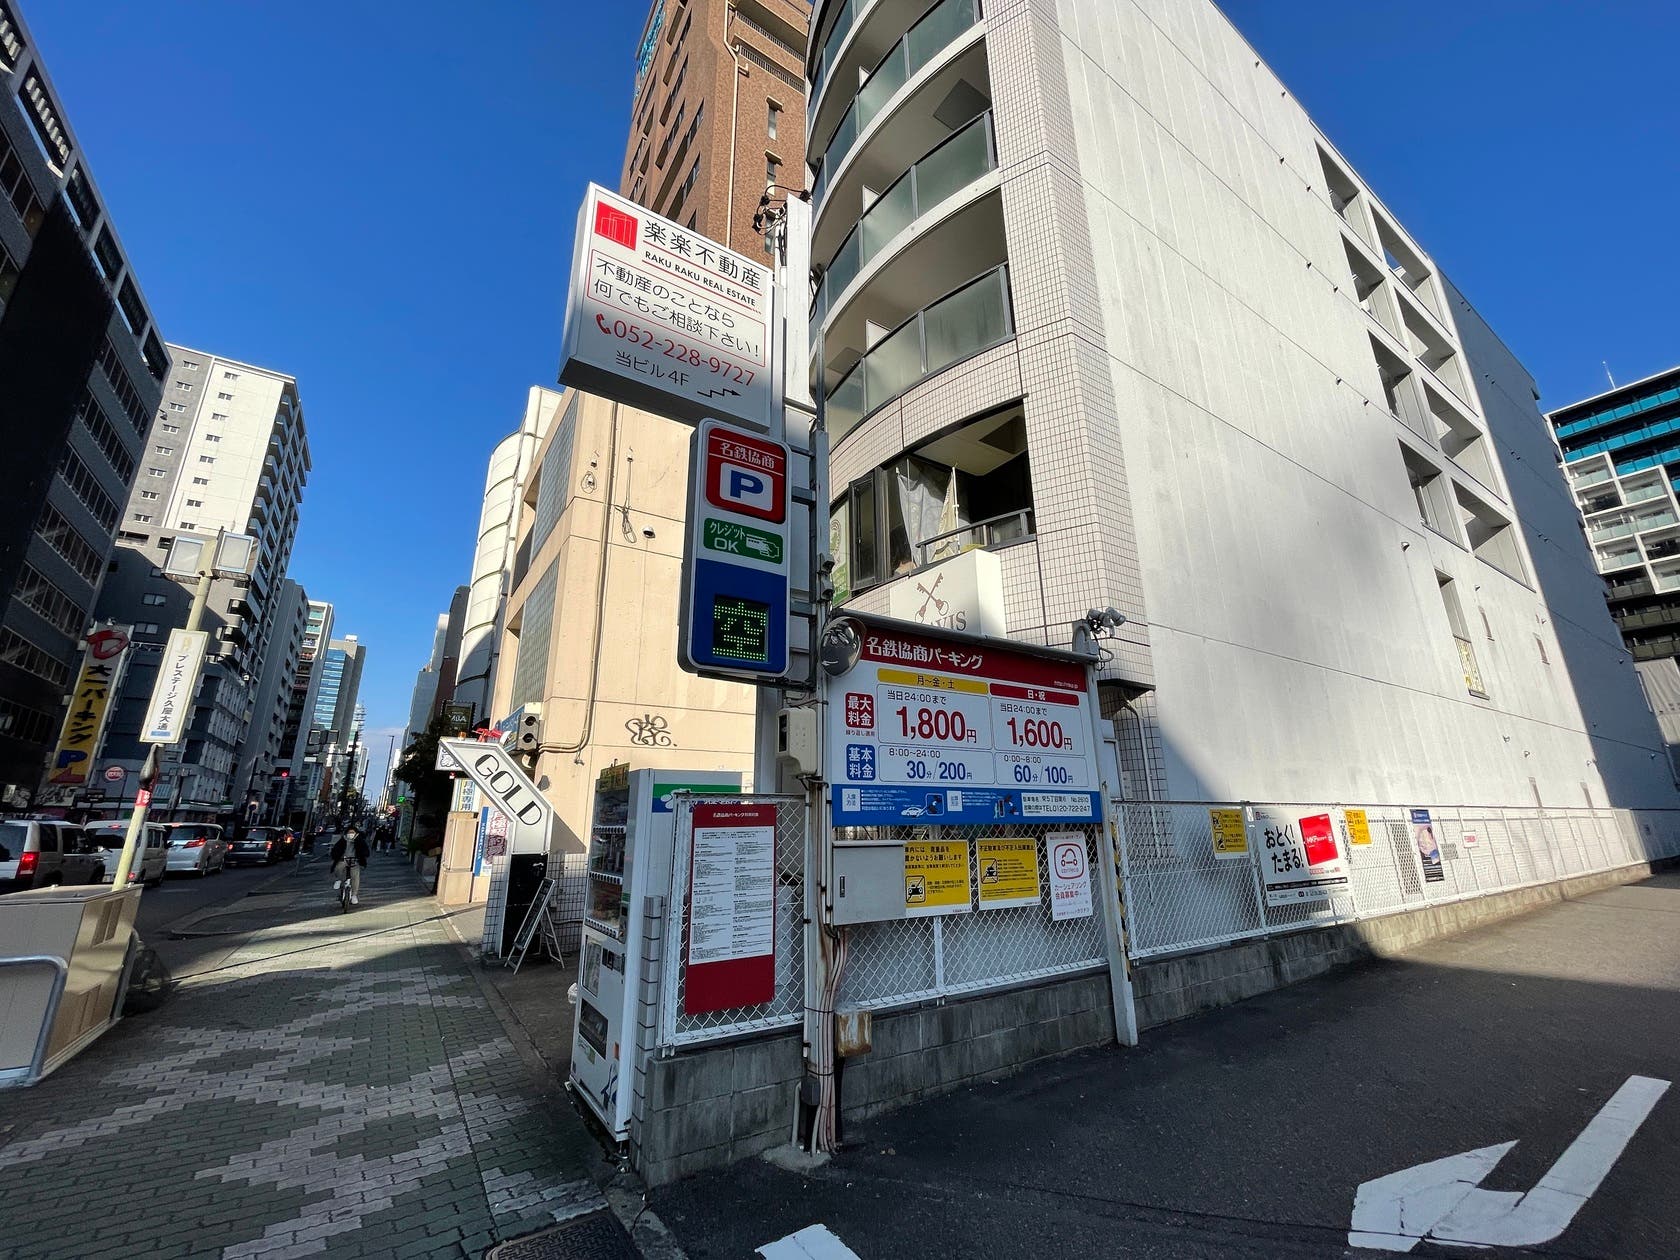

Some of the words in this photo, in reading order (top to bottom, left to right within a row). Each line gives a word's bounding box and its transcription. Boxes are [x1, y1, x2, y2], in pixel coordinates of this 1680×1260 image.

[644, 219, 761, 290] 楽楽不動産
[645, 251, 672, 269] RAKU
[675, 263, 700, 281] RAKU
[703, 276, 724, 293] REAL
[726, 287, 756, 307] ESTATE
[596, 257, 735, 329] 不動産のことなら
[614, 320, 755, 386] 052-228-9727
[720, 441, 775, 469] 名鉄協商
[729, 469, 764, 499] P
[709, 520, 746, 539] クレジット
[713, 537, 739, 553] OK
[931, 611, 966, 631] VIS
[866, 636, 983, 670] 名鉄協商パーキング
[847, 695, 872, 711] 最大
[887, 690, 947, 706] 当日24:00まで
[848, 710, 872, 727] 料金
[1000, 703, 1048, 716] 当日24:00まで
[58, 750, 88, 768] P
[848, 746, 873, 763] 基本
[848, 763, 874, 779] 料金
[474, 753, 542, 826] GOLD
